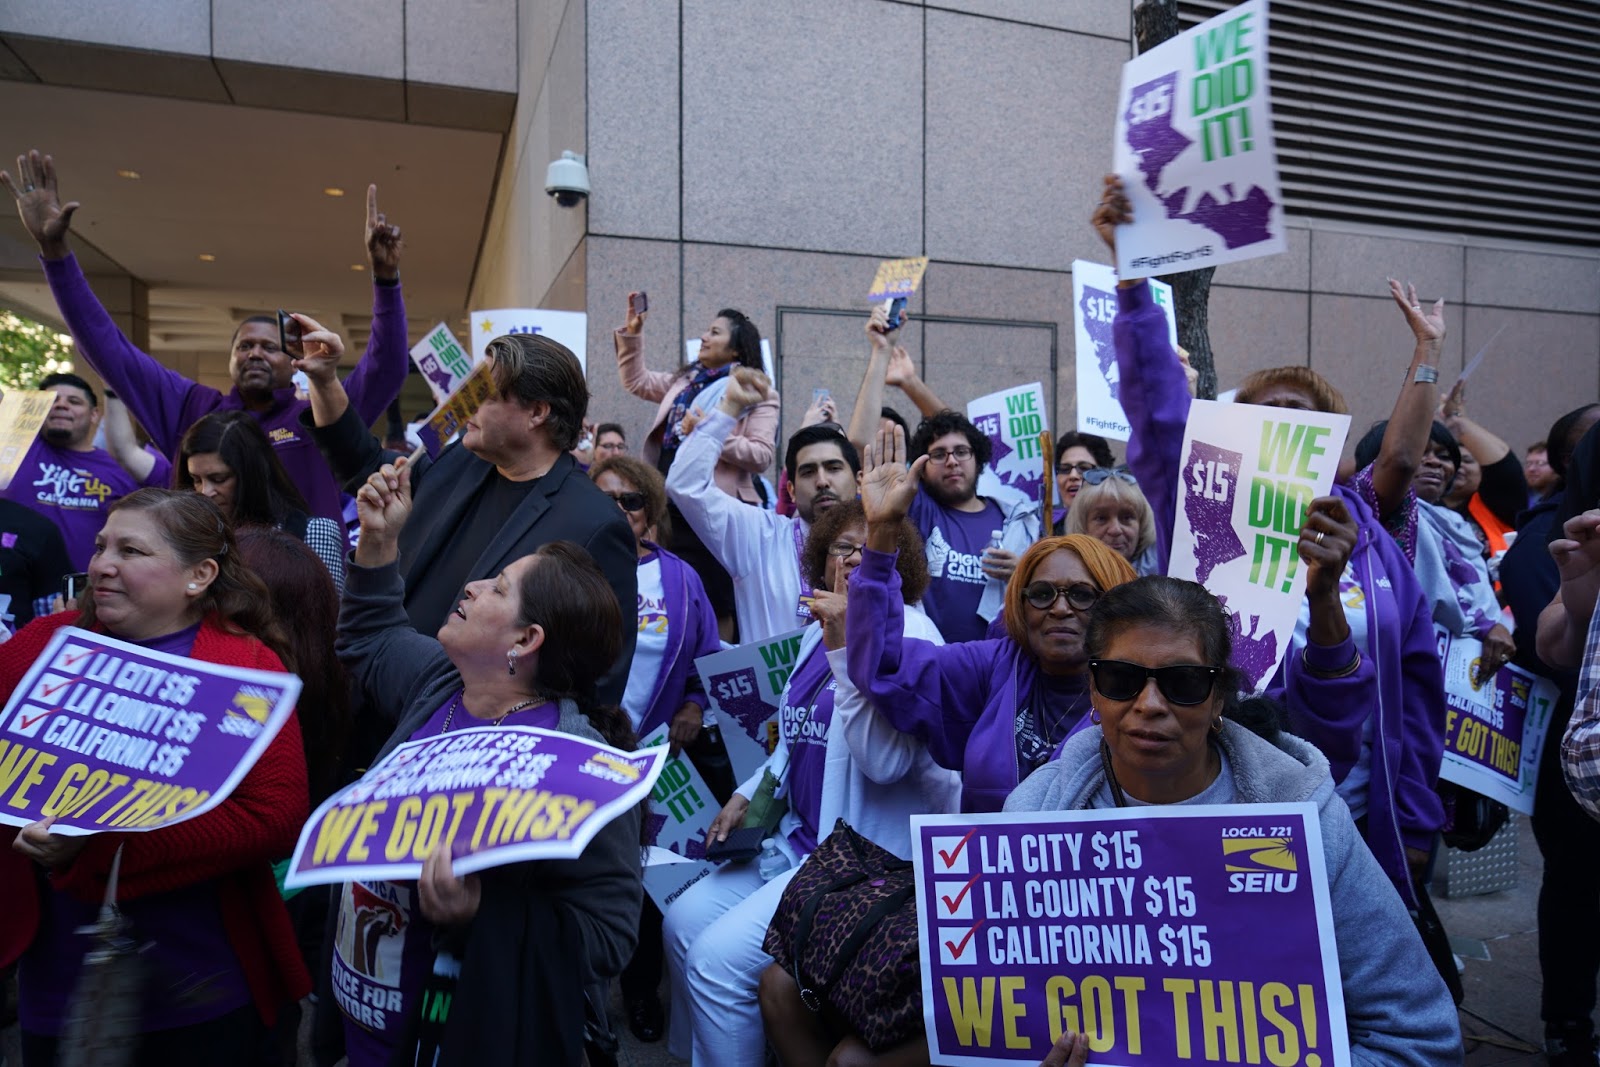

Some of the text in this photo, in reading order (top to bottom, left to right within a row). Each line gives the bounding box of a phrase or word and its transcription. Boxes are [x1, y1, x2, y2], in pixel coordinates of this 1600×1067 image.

[1193, 11, 1256, 70] WE
[1192, 58, 1254, 117] DID
[1201, 107, 1255, 162] IT!
[1131, 246, 1214, 269] #FightFor15
[1086, 296, 1117, 323] $15
[429, 328, 450, 351] WE
[439, 343, 462, 367] DID
[450, 358, 471, 379] IT!
[1005, 391, 1038, 415] WE
[1009, 413, 1042, 438] DID
[1086, 416, 1132, 432] #FightFor1
[1016, 436, 1042, 460] IT!
[1258, 420, 1331, 480] WE
[33, 463, 86, 497] Lift
[1192, 459, 1230, 502] $15
[1248, 476, 1314, 536] DID
[947, 562, 985, 579] CALIF
[948, 550, 983, 567] DIGN
[1248, 533, 1300, 594] IT!
[84, 655, 122, 685] LA
[118, 663, 170, 697] CITY
[718, 674, 753, 699] $15
[63, 684, 102, 714] LA
[95, 694, 175, 736] COUNTY
[42, 715, 158, 771] CALIFORNIA
[445, 732, 502, 753] CITY
[496, 732, 542, 753] $15
[1446, 710, 1458, 746] E
[1456, 716, 1490, 760] GOT
[1489, 730, 1521, 777] THIS!
[41, 763, 130, 819] GOT
[667, 784, 705, 824] IT!
[313, 786, 596, 865] WE GOT THIS!
[1221, 826, 1292, 838] LOCAL 721
[979, 830, 1142, 874] LA CITY $15
[664, 868, 710, 906] #FightFor15
[983, 876, 1197, 919] LA COUNTY $15
[1228, 873, 1298, 893] SEIU
[987, 923, 1212, 967] CALIFORNIA $15
[363, 983, 403, 1013] FOR
[942, 975, 1322, 1067] WE GOT THIS!
